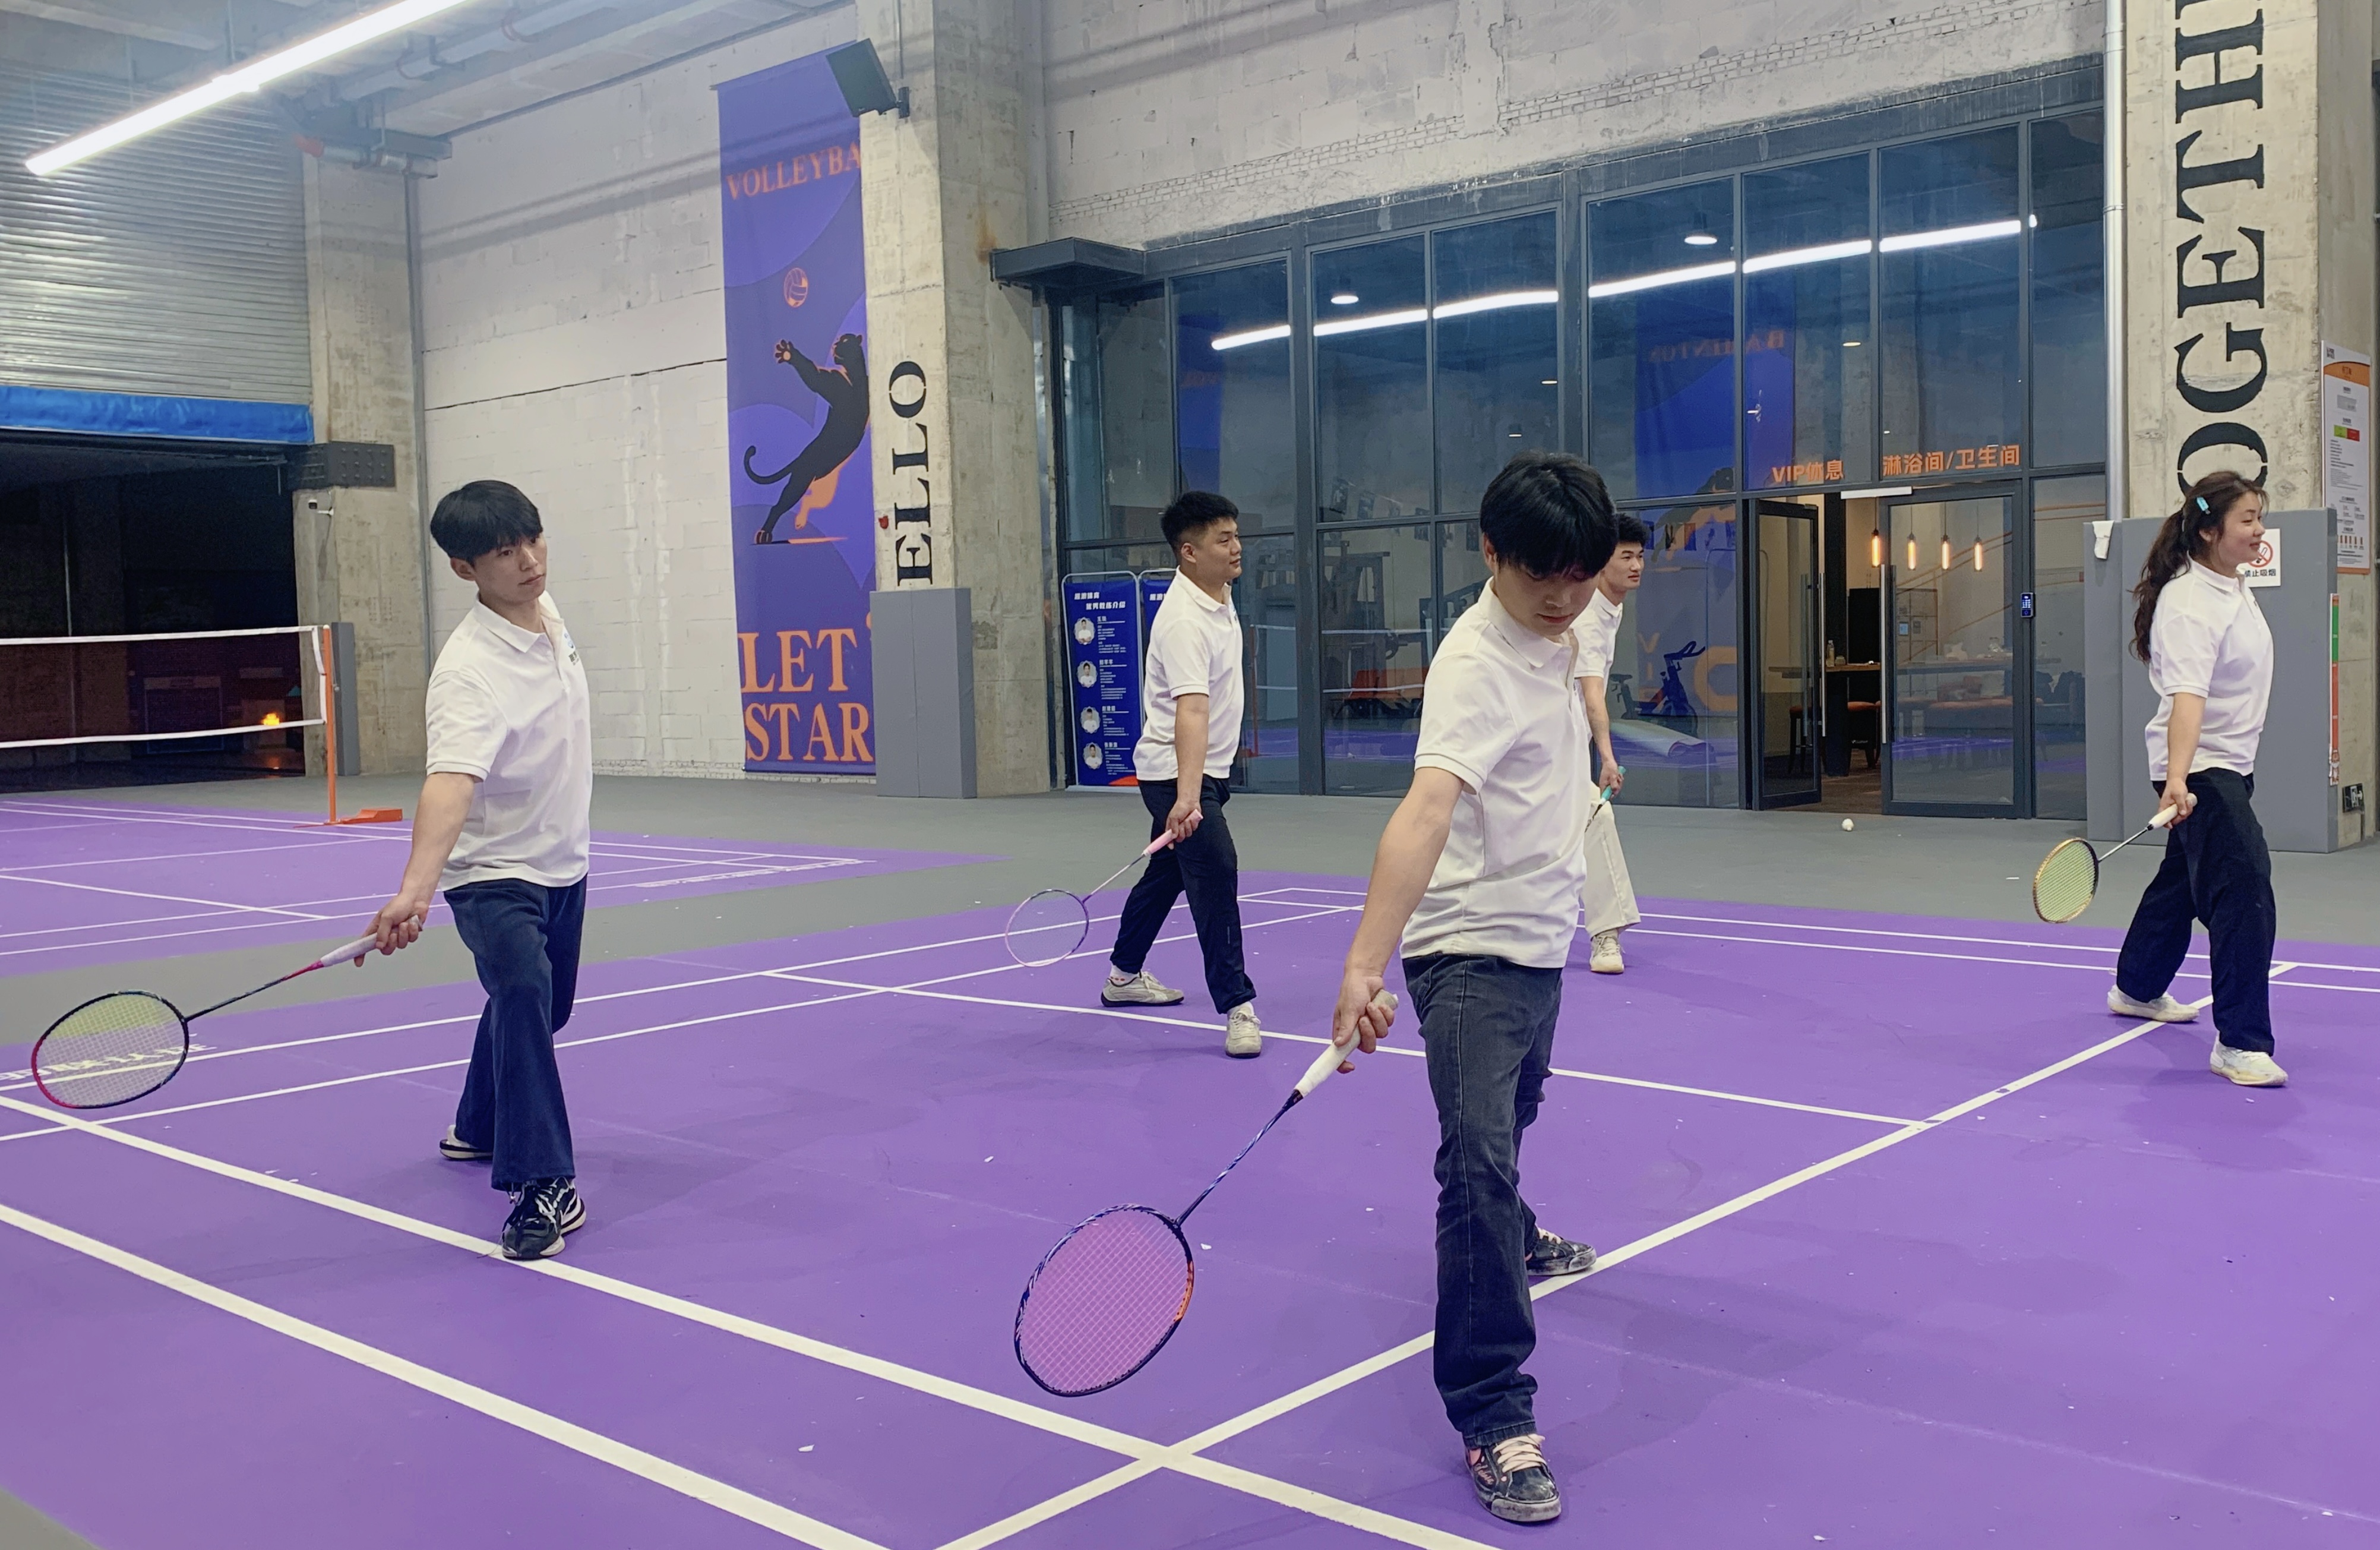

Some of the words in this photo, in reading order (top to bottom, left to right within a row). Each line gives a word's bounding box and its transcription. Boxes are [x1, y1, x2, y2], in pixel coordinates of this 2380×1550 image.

[2173, 0, 2268, 494] OGETH
[1771, 459, 1844, 483] VIP休息
[1882, 444, 2020, 476] 淋浴间/卫生间
